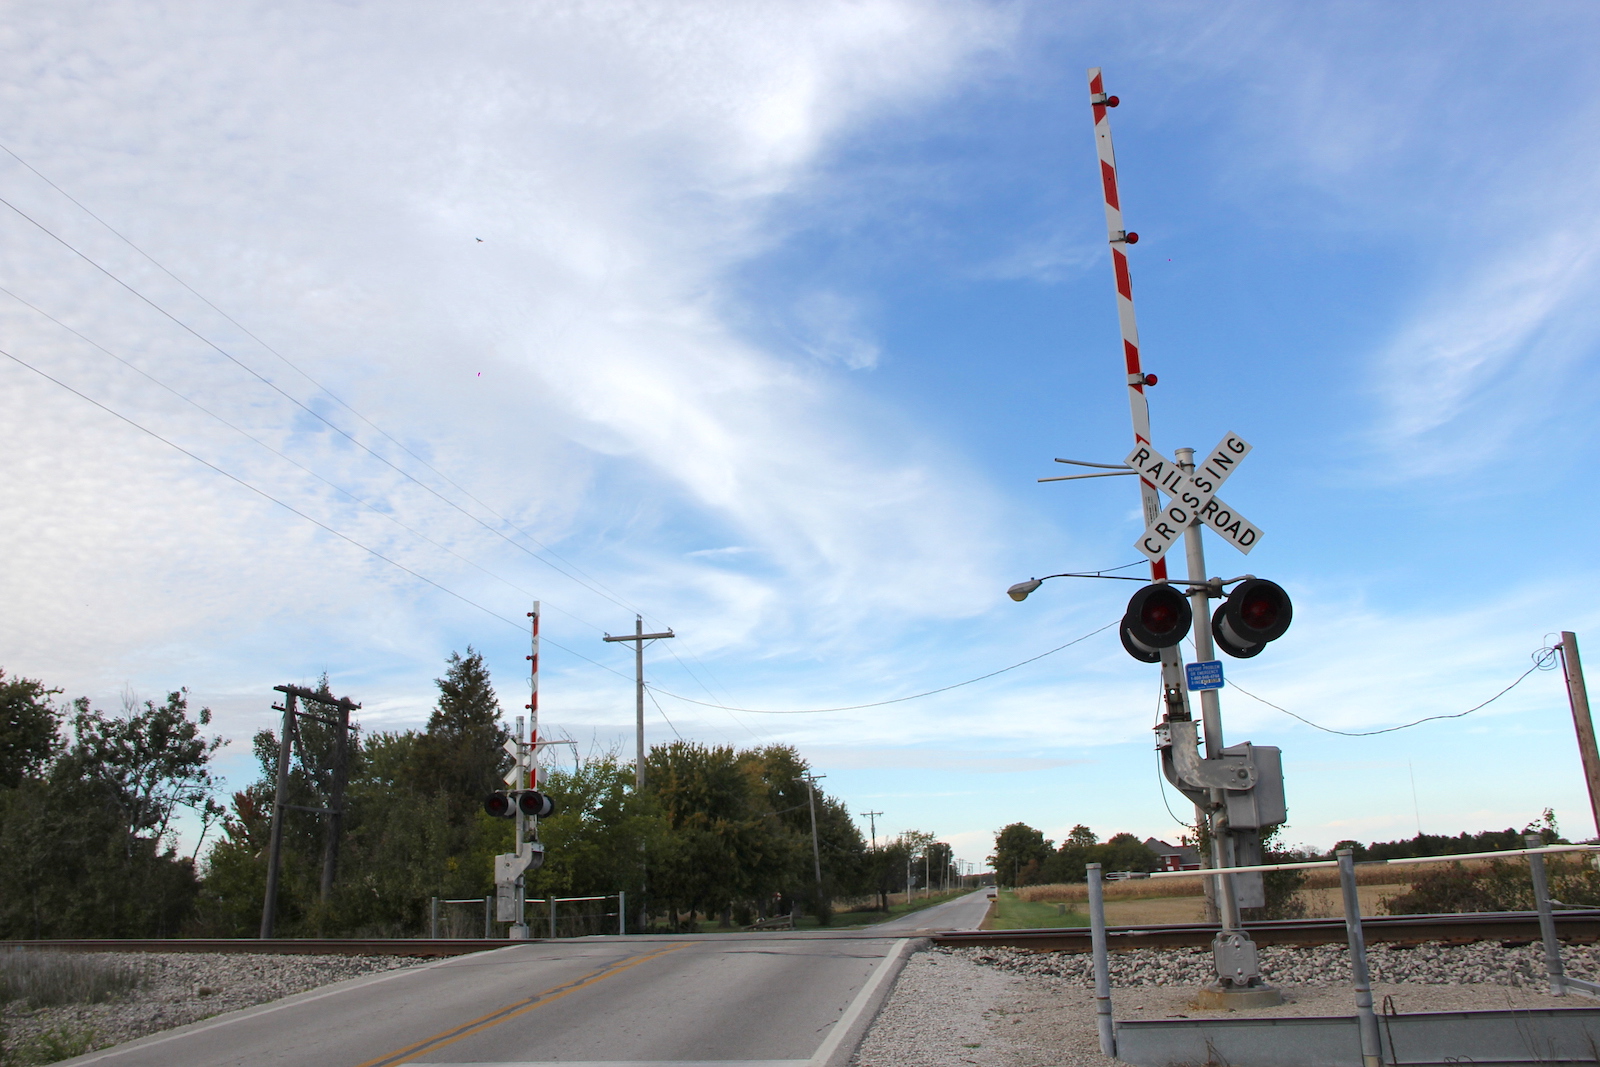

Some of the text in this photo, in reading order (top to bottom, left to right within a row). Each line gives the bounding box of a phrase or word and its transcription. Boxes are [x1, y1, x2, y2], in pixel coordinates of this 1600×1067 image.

[1131, 447, 1182, 495] RAIL
[1201, 500, 1256, 546] ROAD
[1144, 438, 1245, 554] CROSSING
